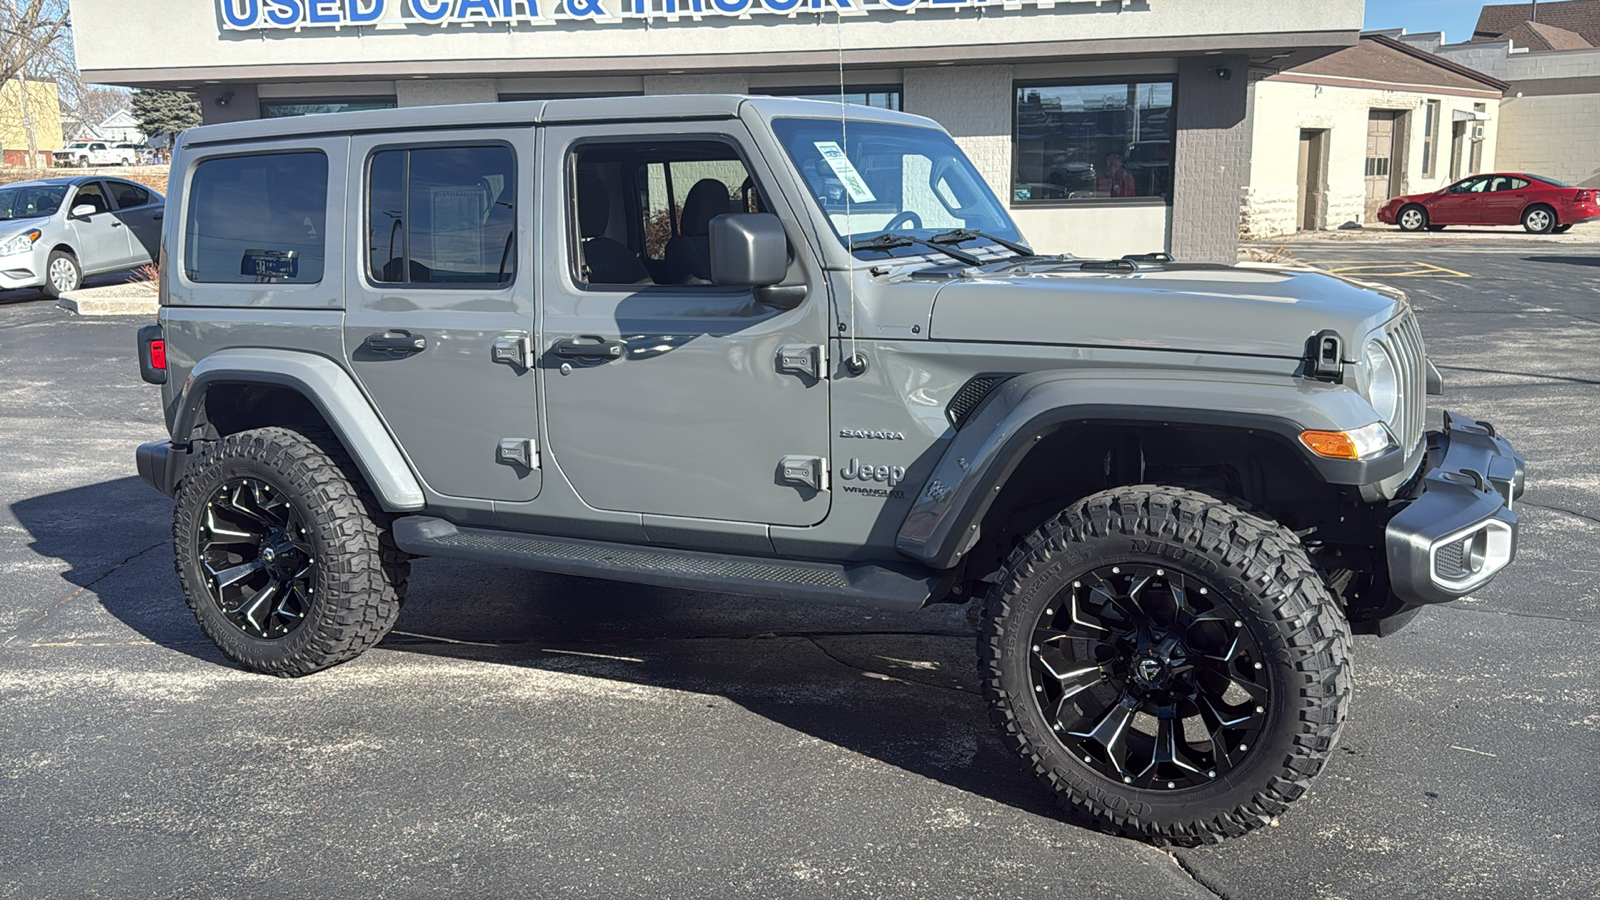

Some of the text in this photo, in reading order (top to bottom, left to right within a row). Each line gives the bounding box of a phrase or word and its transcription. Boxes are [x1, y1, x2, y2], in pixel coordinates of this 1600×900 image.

[839, 429, 905, 441] SAHARA
[840, 457, 905, 487] Jeep
[842, 486, 905, 498] WRANGLER
[1130, 539, 1294, 669] MUD CLAW
[1053, 766, 1152, 818] COMP
